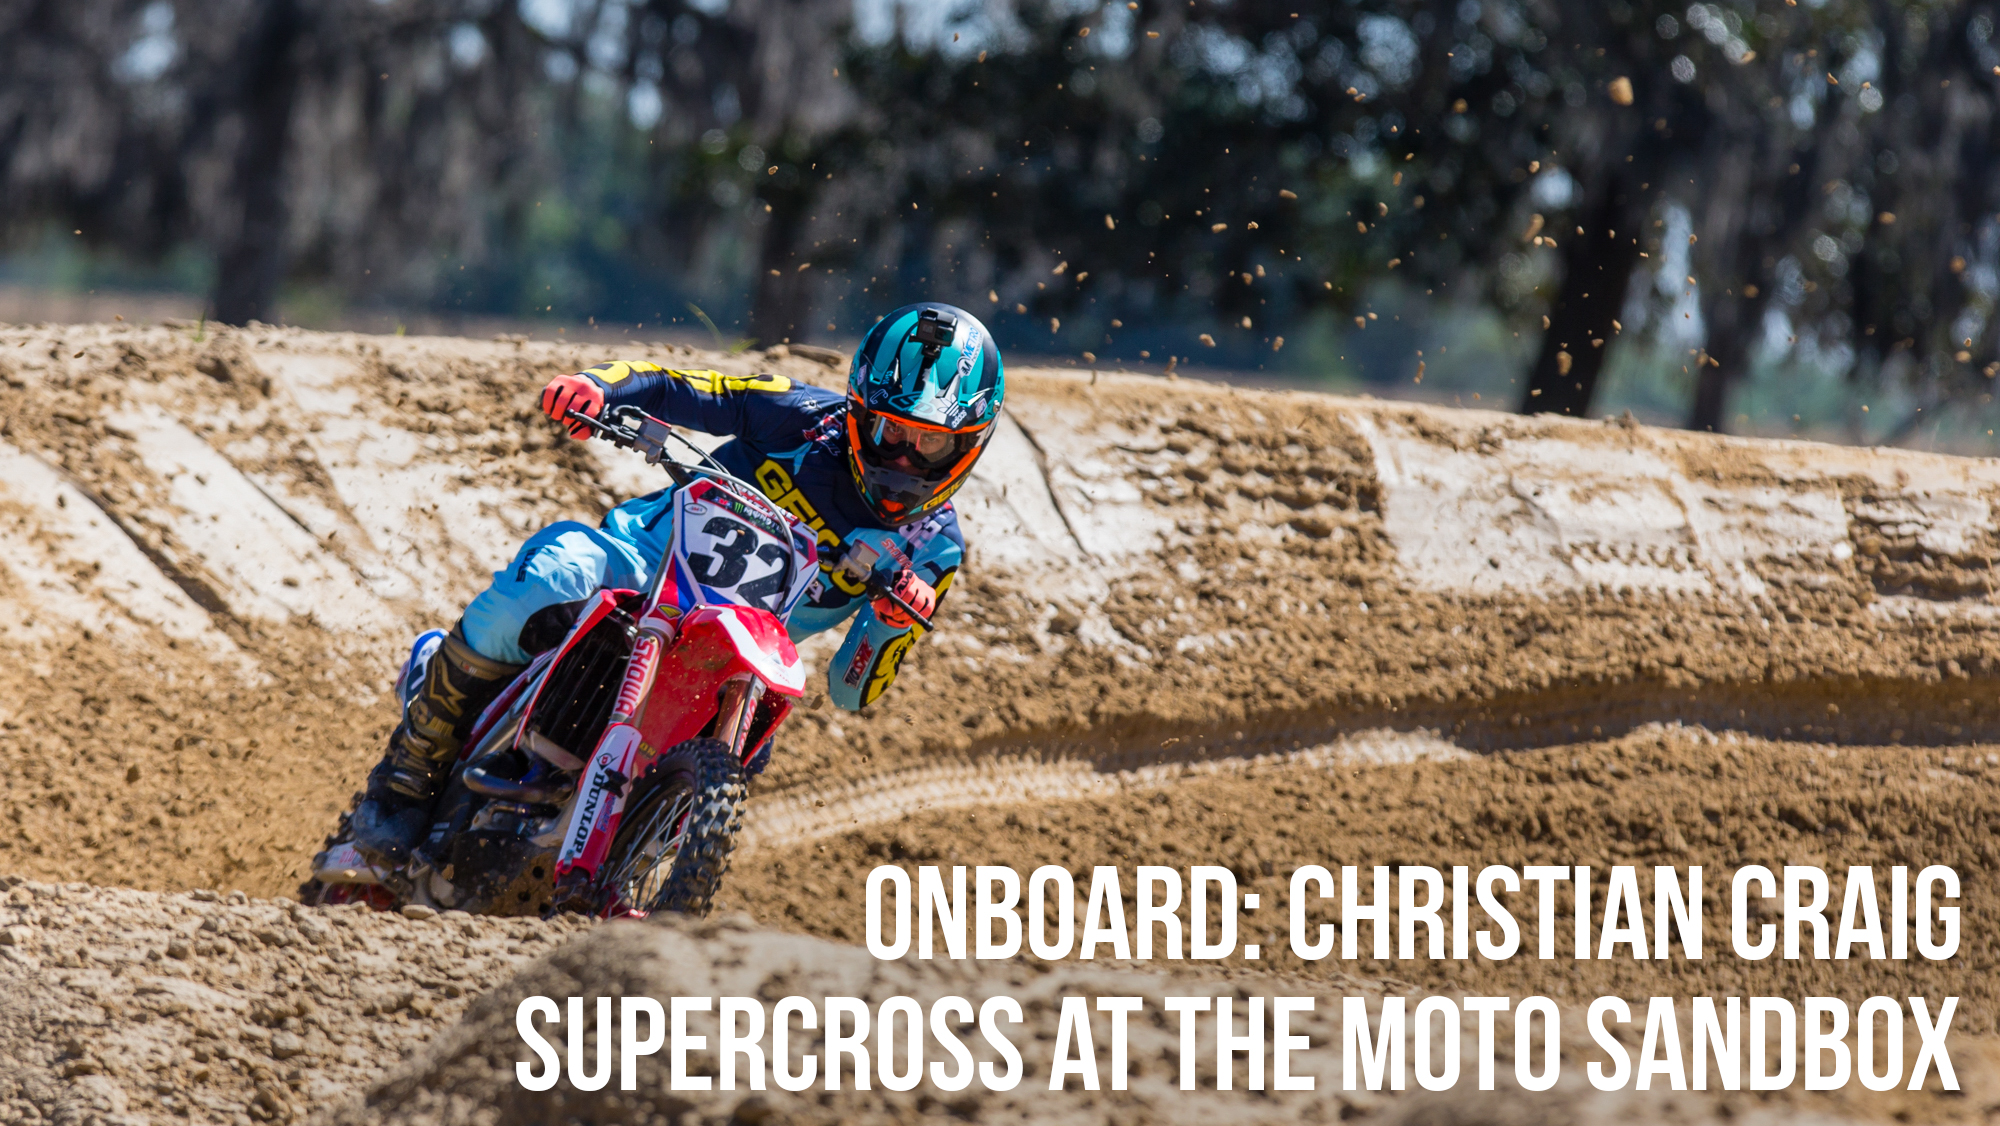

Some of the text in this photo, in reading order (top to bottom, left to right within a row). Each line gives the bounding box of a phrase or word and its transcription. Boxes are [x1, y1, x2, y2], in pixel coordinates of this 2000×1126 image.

[963, 326, 979, 359] METRO
[951, 409, 968, 428] adidas
[687, 516, 792, 615] 32
[881, 538, 913, 570] SHOWA
[614, 637, 657, 717] SHOWA
[573, 772, 606, 854] DUNLOP
